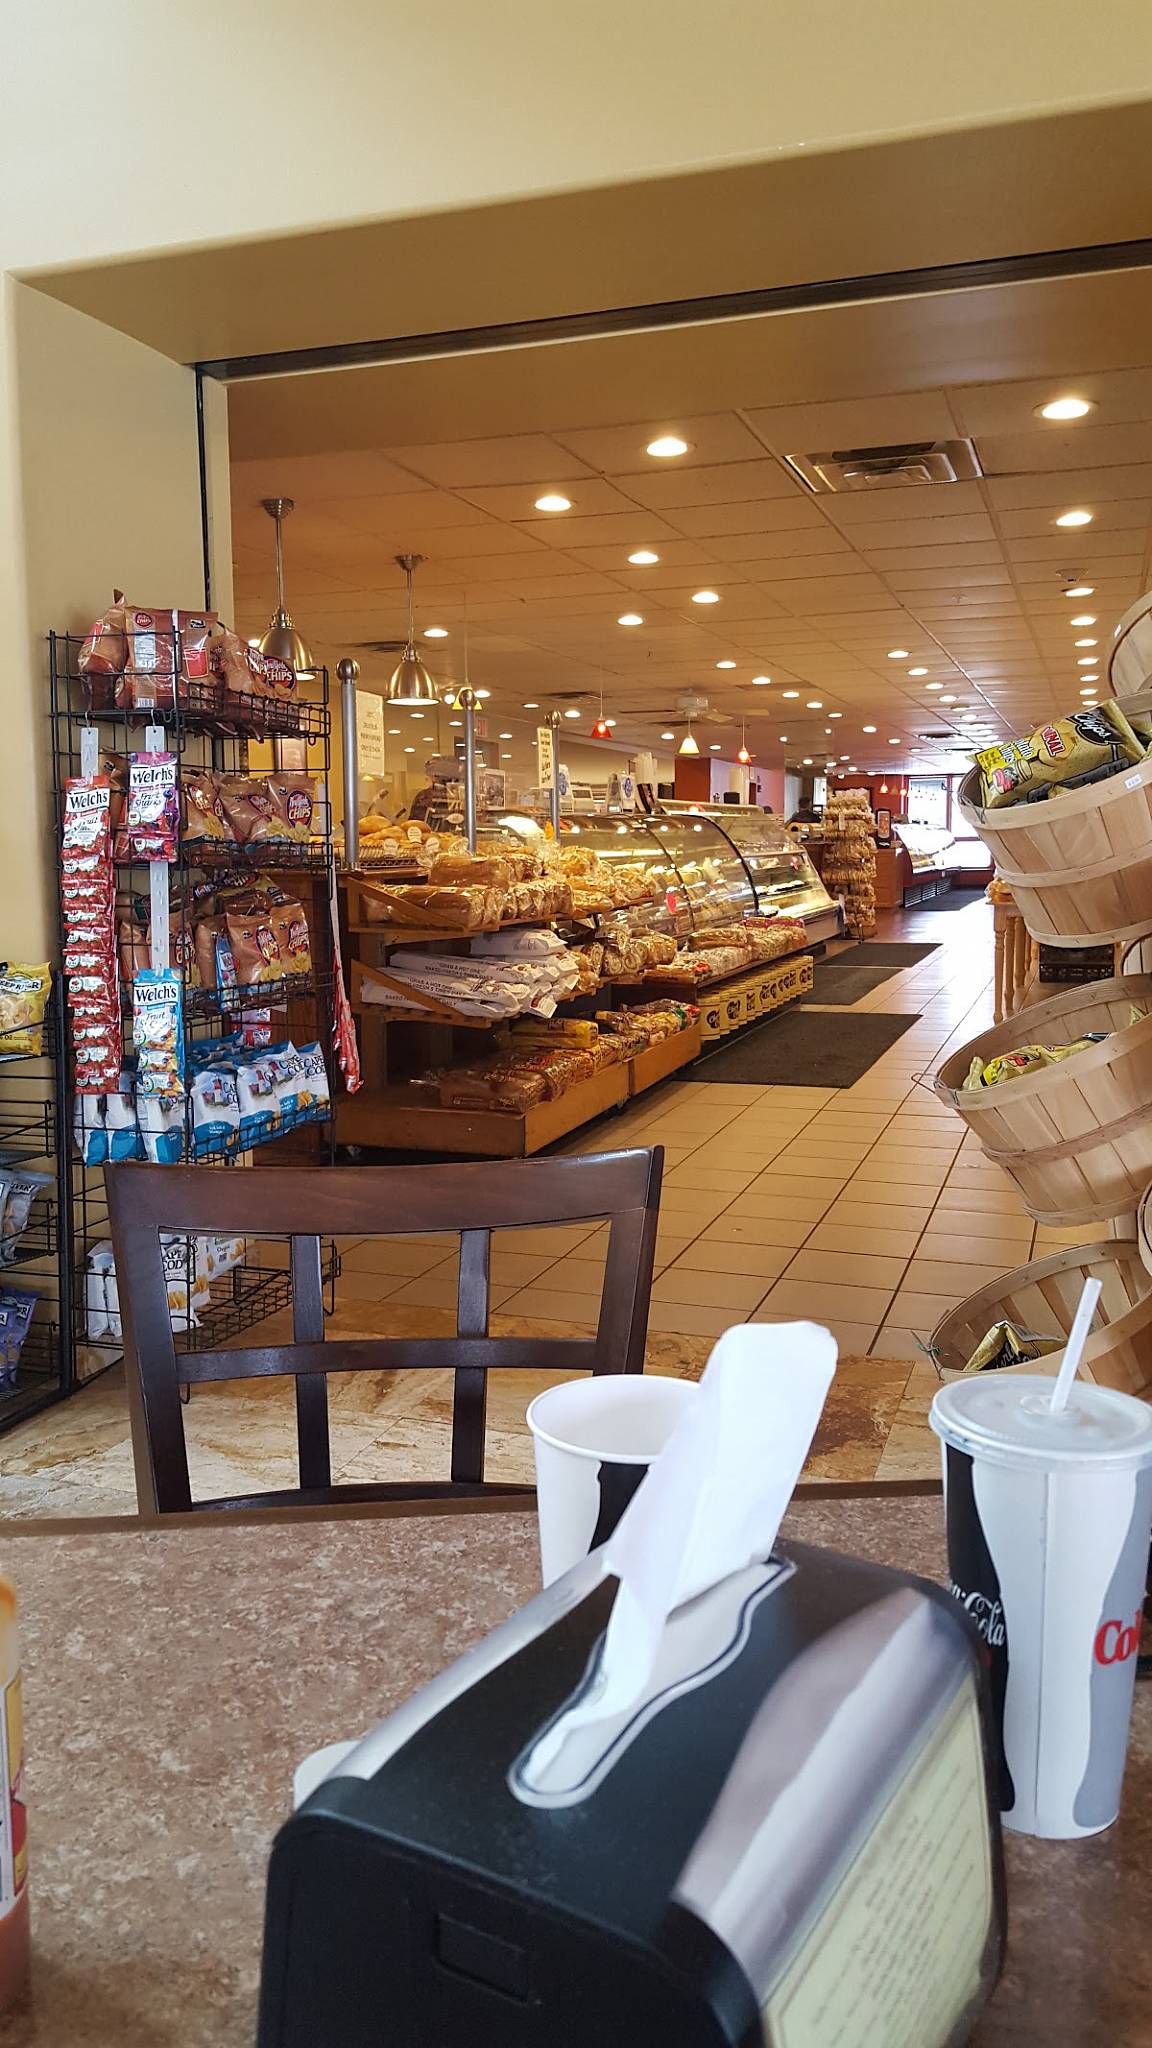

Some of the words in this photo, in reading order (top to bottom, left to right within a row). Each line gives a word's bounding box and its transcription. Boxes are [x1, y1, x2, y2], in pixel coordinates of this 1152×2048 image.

[133, 767, 173, 783] Welch's
[69, 791, 108, 809] Welch's
[288, 806, 311, 819] CHIPS
[135, 985, 177, 1002] Welch's
